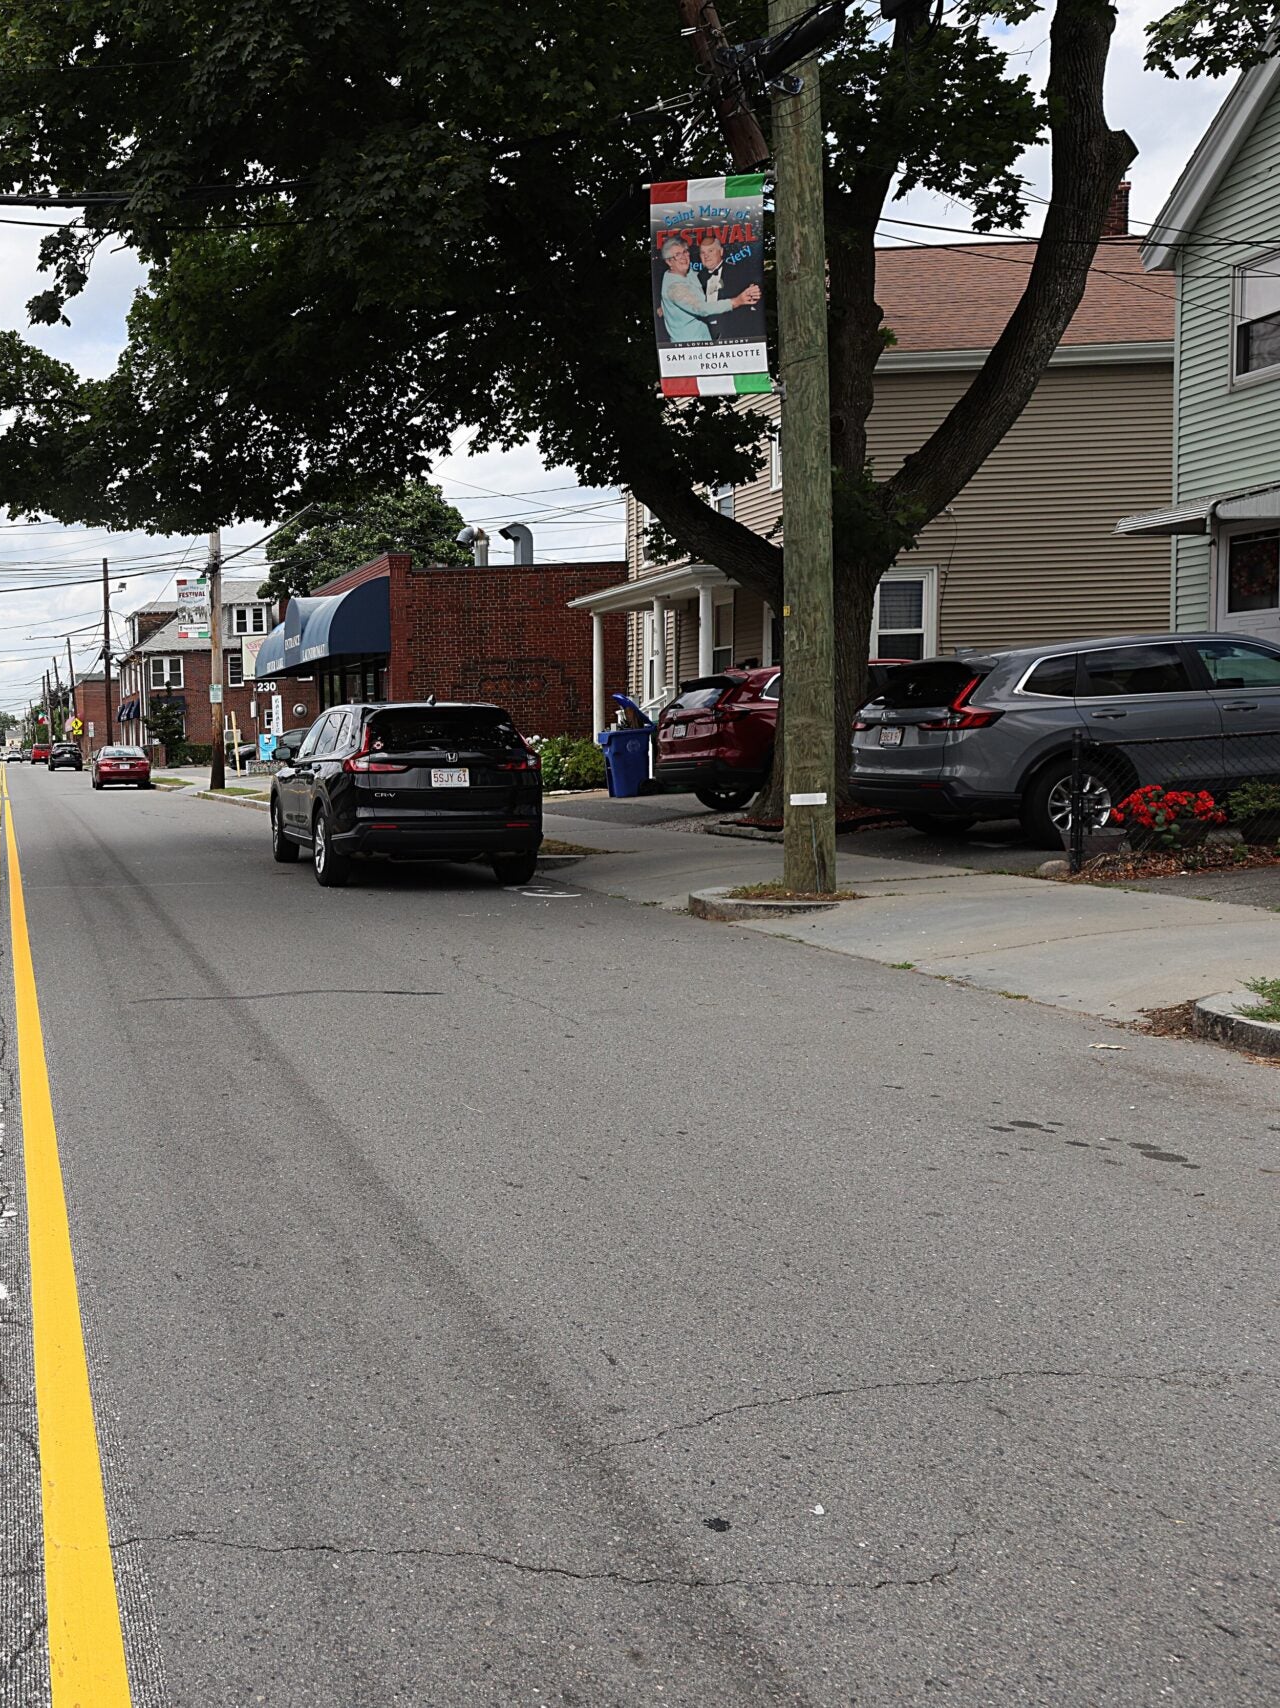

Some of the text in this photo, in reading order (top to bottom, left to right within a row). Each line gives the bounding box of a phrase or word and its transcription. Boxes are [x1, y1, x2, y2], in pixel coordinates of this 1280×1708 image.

[664, 205, 751, 226] Saint Mary of
[666, 354, 685, 362] SAM
[705, 349, 761, 360] CHARLOTTE
[700, 361, 729, 370] PROIA
[257, 682, 277, 692] 230
[433, 773, 468, 783] 5SJY 61
